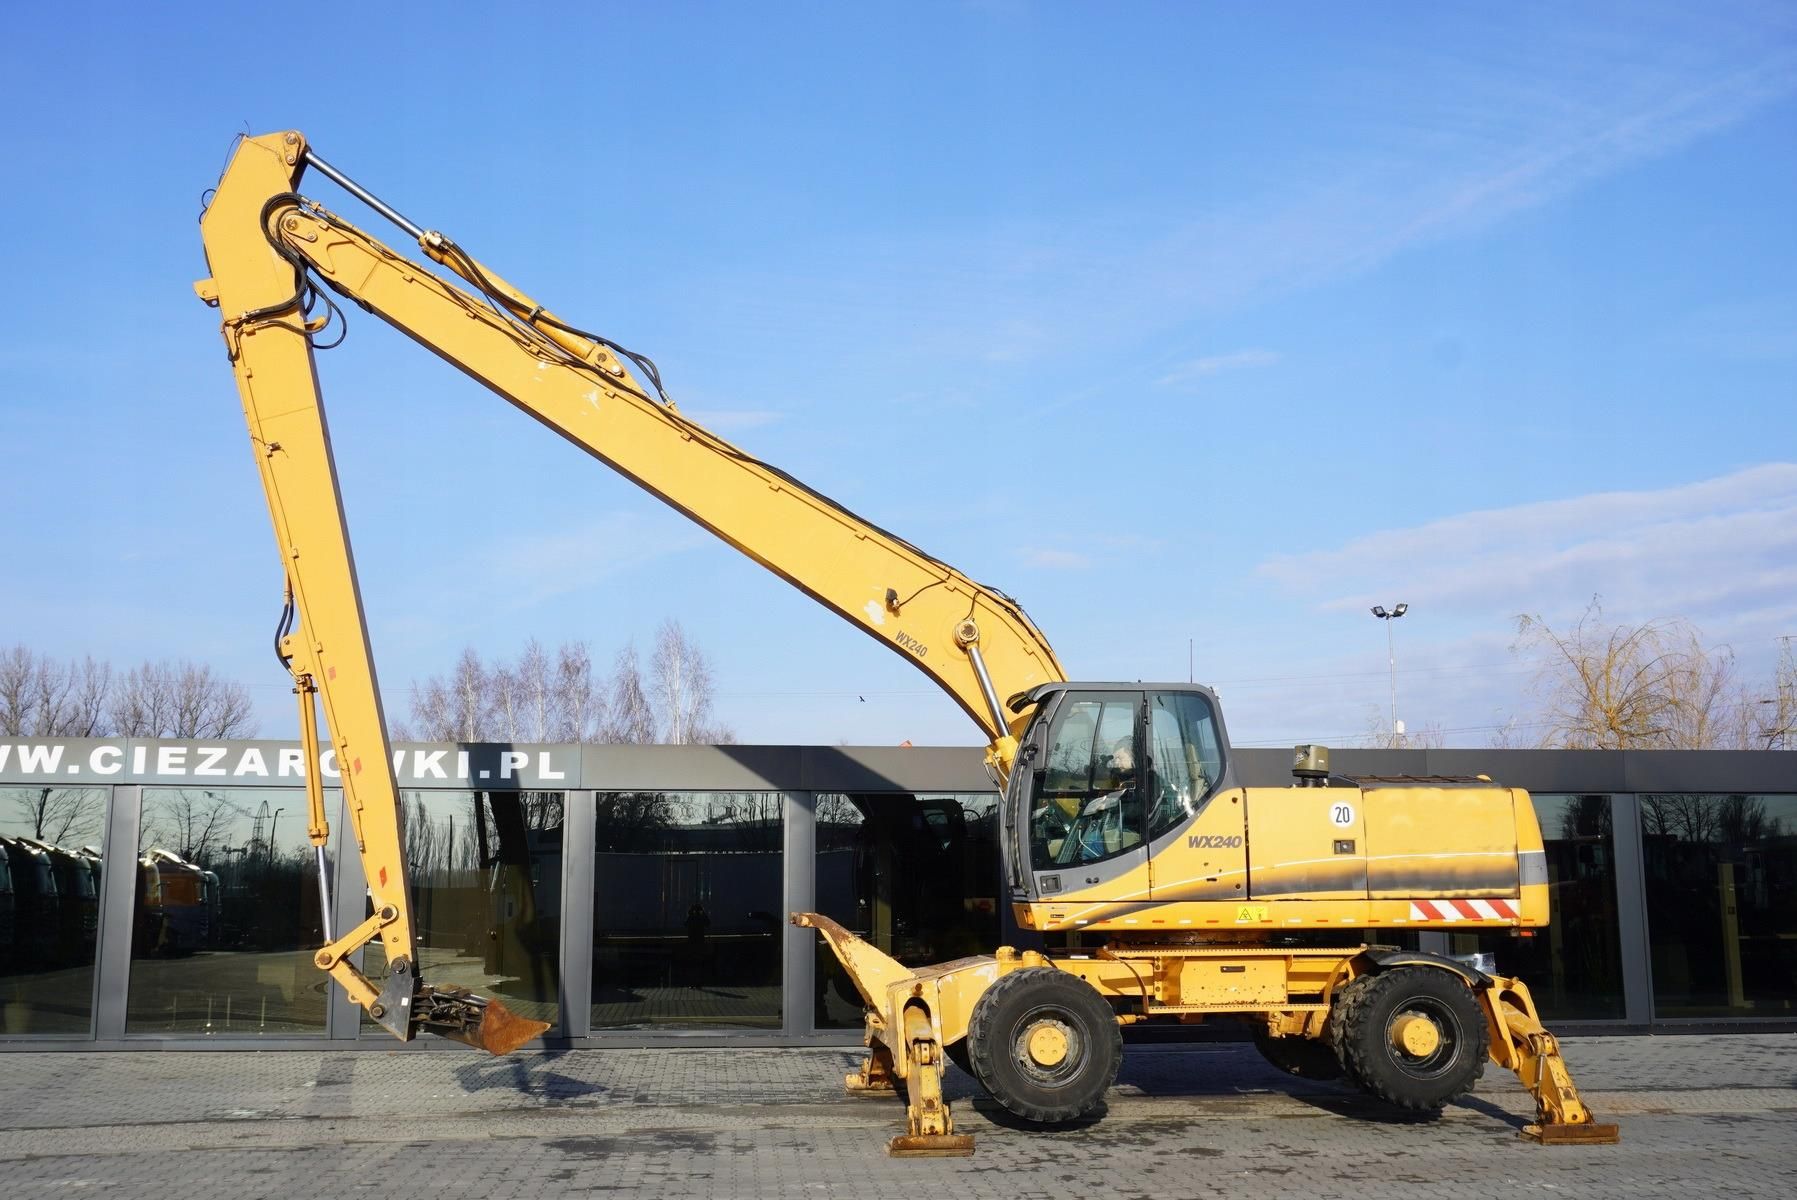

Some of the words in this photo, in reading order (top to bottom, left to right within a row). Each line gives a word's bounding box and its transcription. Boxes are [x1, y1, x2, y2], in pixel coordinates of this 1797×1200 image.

[895, 630, 928, 657] WX240
[0, 745, 565, 780] W.CIEZAROKI.PL
[1335, 806, 1351, 823] 20
[1188, 835, 1243, 849] WX240
